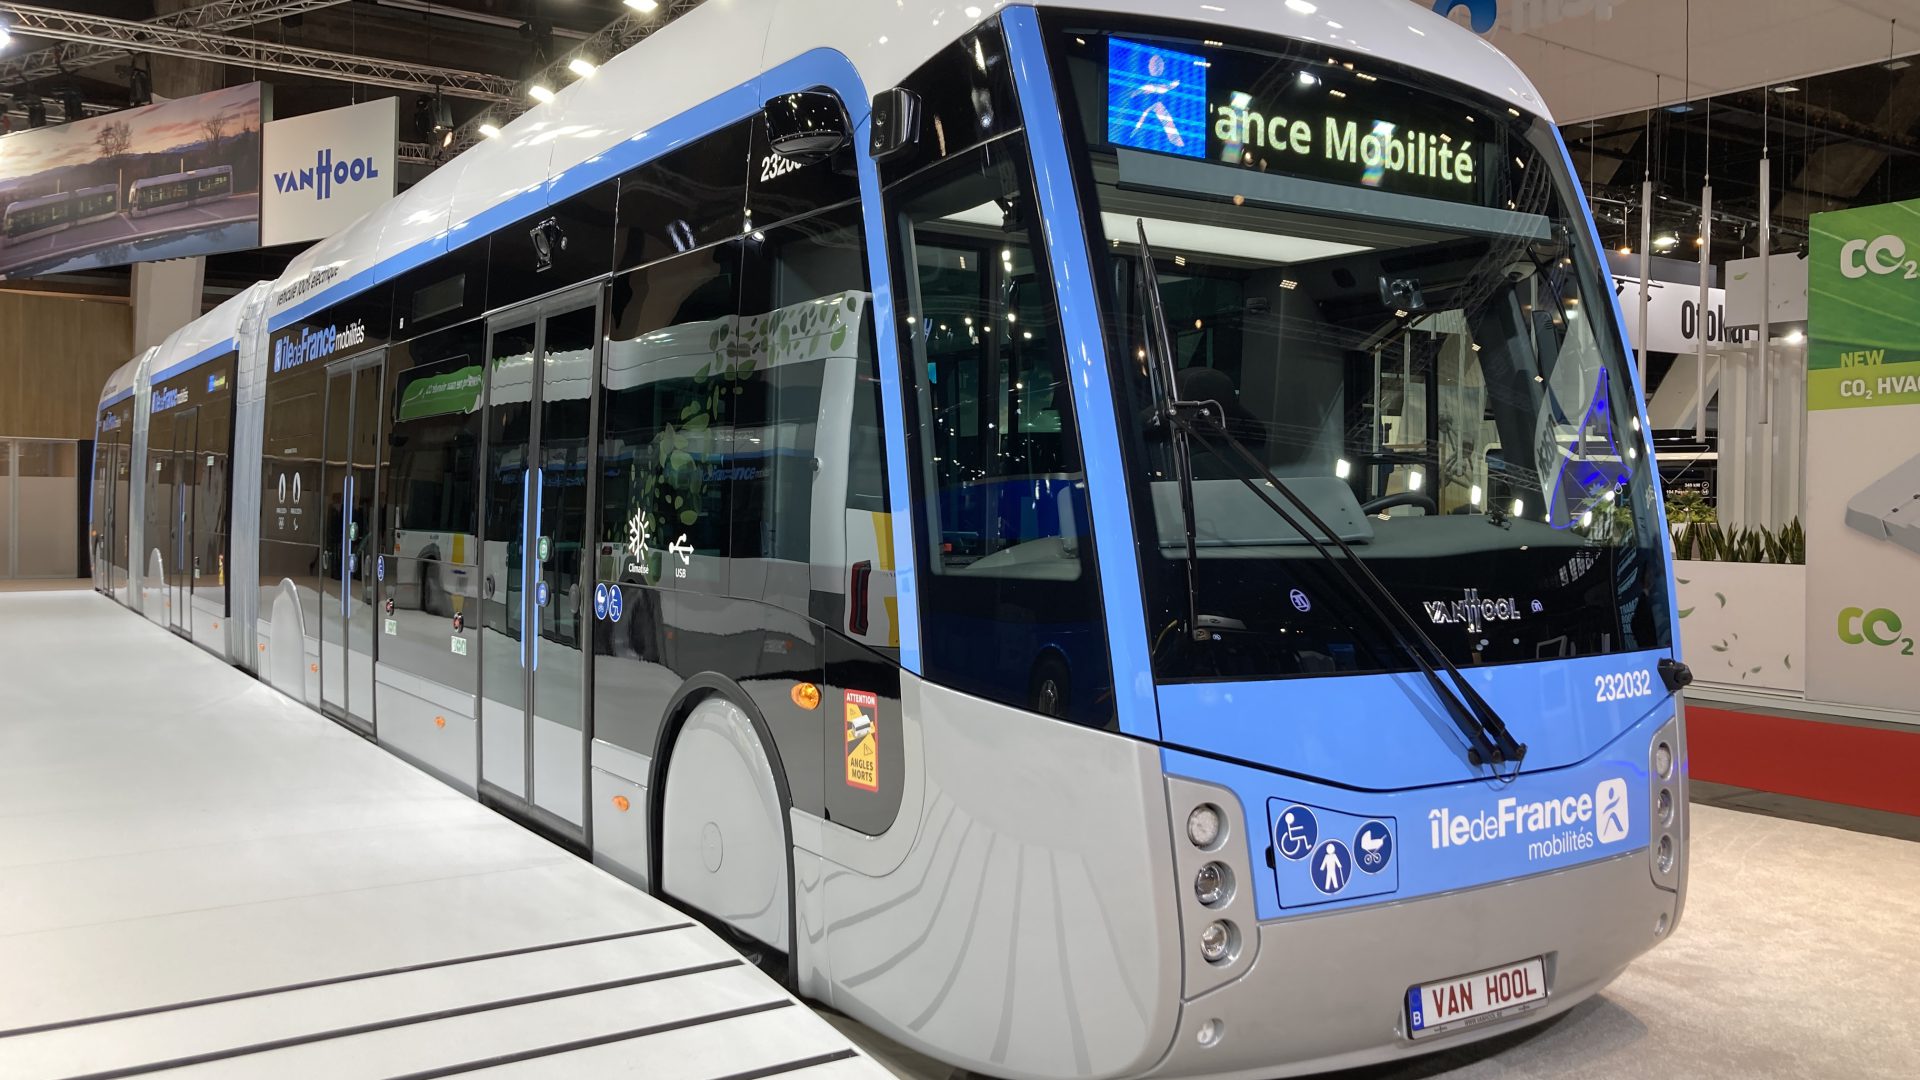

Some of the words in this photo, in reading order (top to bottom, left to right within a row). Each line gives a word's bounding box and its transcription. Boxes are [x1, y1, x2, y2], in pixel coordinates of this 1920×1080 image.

[1210, 101, 1312, 155] ance
[1325, 116, 1477, 184] Mobilité
[760, 153, 807, 182] 2320
[1840, 349, 1885, 370] NEW
[628, 563, 649, 574] Climatisé
[675, 567, 687, 579] USB
[1594, 669, 1652, 703] 232032
[846, 693, 875, 705] ATTENTION
[850, 757, 874, 772] ANGLES
[851, 768, 873, 783] MORTS
[1528, 825, 1594, 861] mobilités
[1412, 1011, 1422, 1026] B
[1432, 981, 1473, 1018] VAN
[1485, 967, 1537, 1006] HOOL
